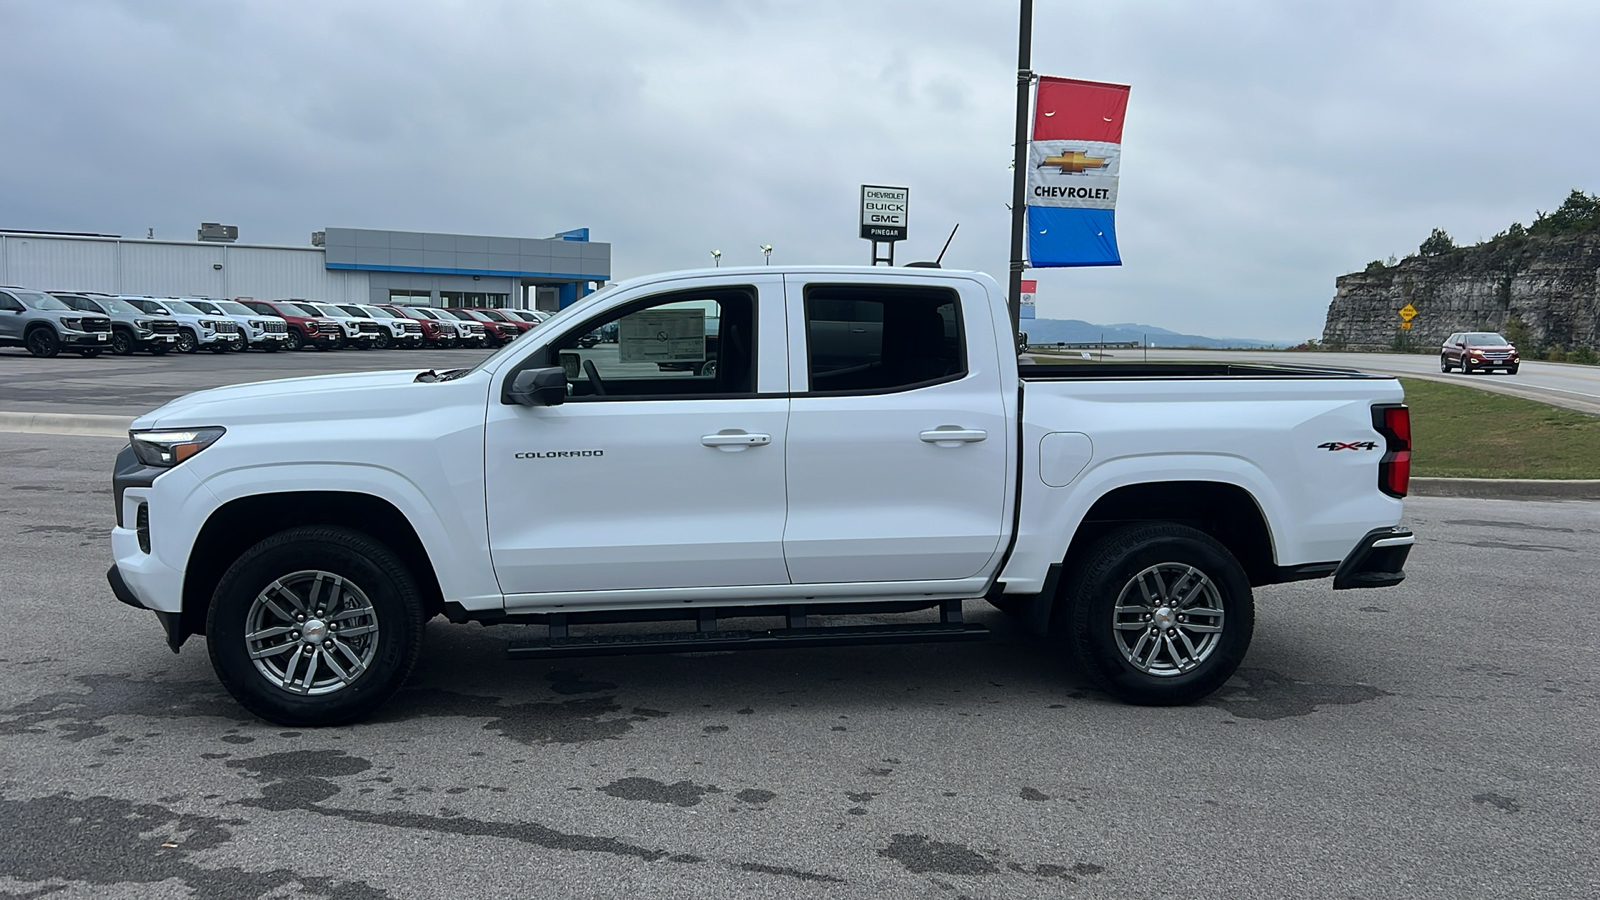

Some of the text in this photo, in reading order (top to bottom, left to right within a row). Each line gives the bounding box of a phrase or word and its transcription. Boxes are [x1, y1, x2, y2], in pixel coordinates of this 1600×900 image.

[866, 191, 905, 200] CHEVROLET
[866, 202, 905, 212] BUICK
[871, 214, 899, 223] GMC
[871, 228, 899, 236] PINEGAR
[515, 450, 604, 459] COLORADO
